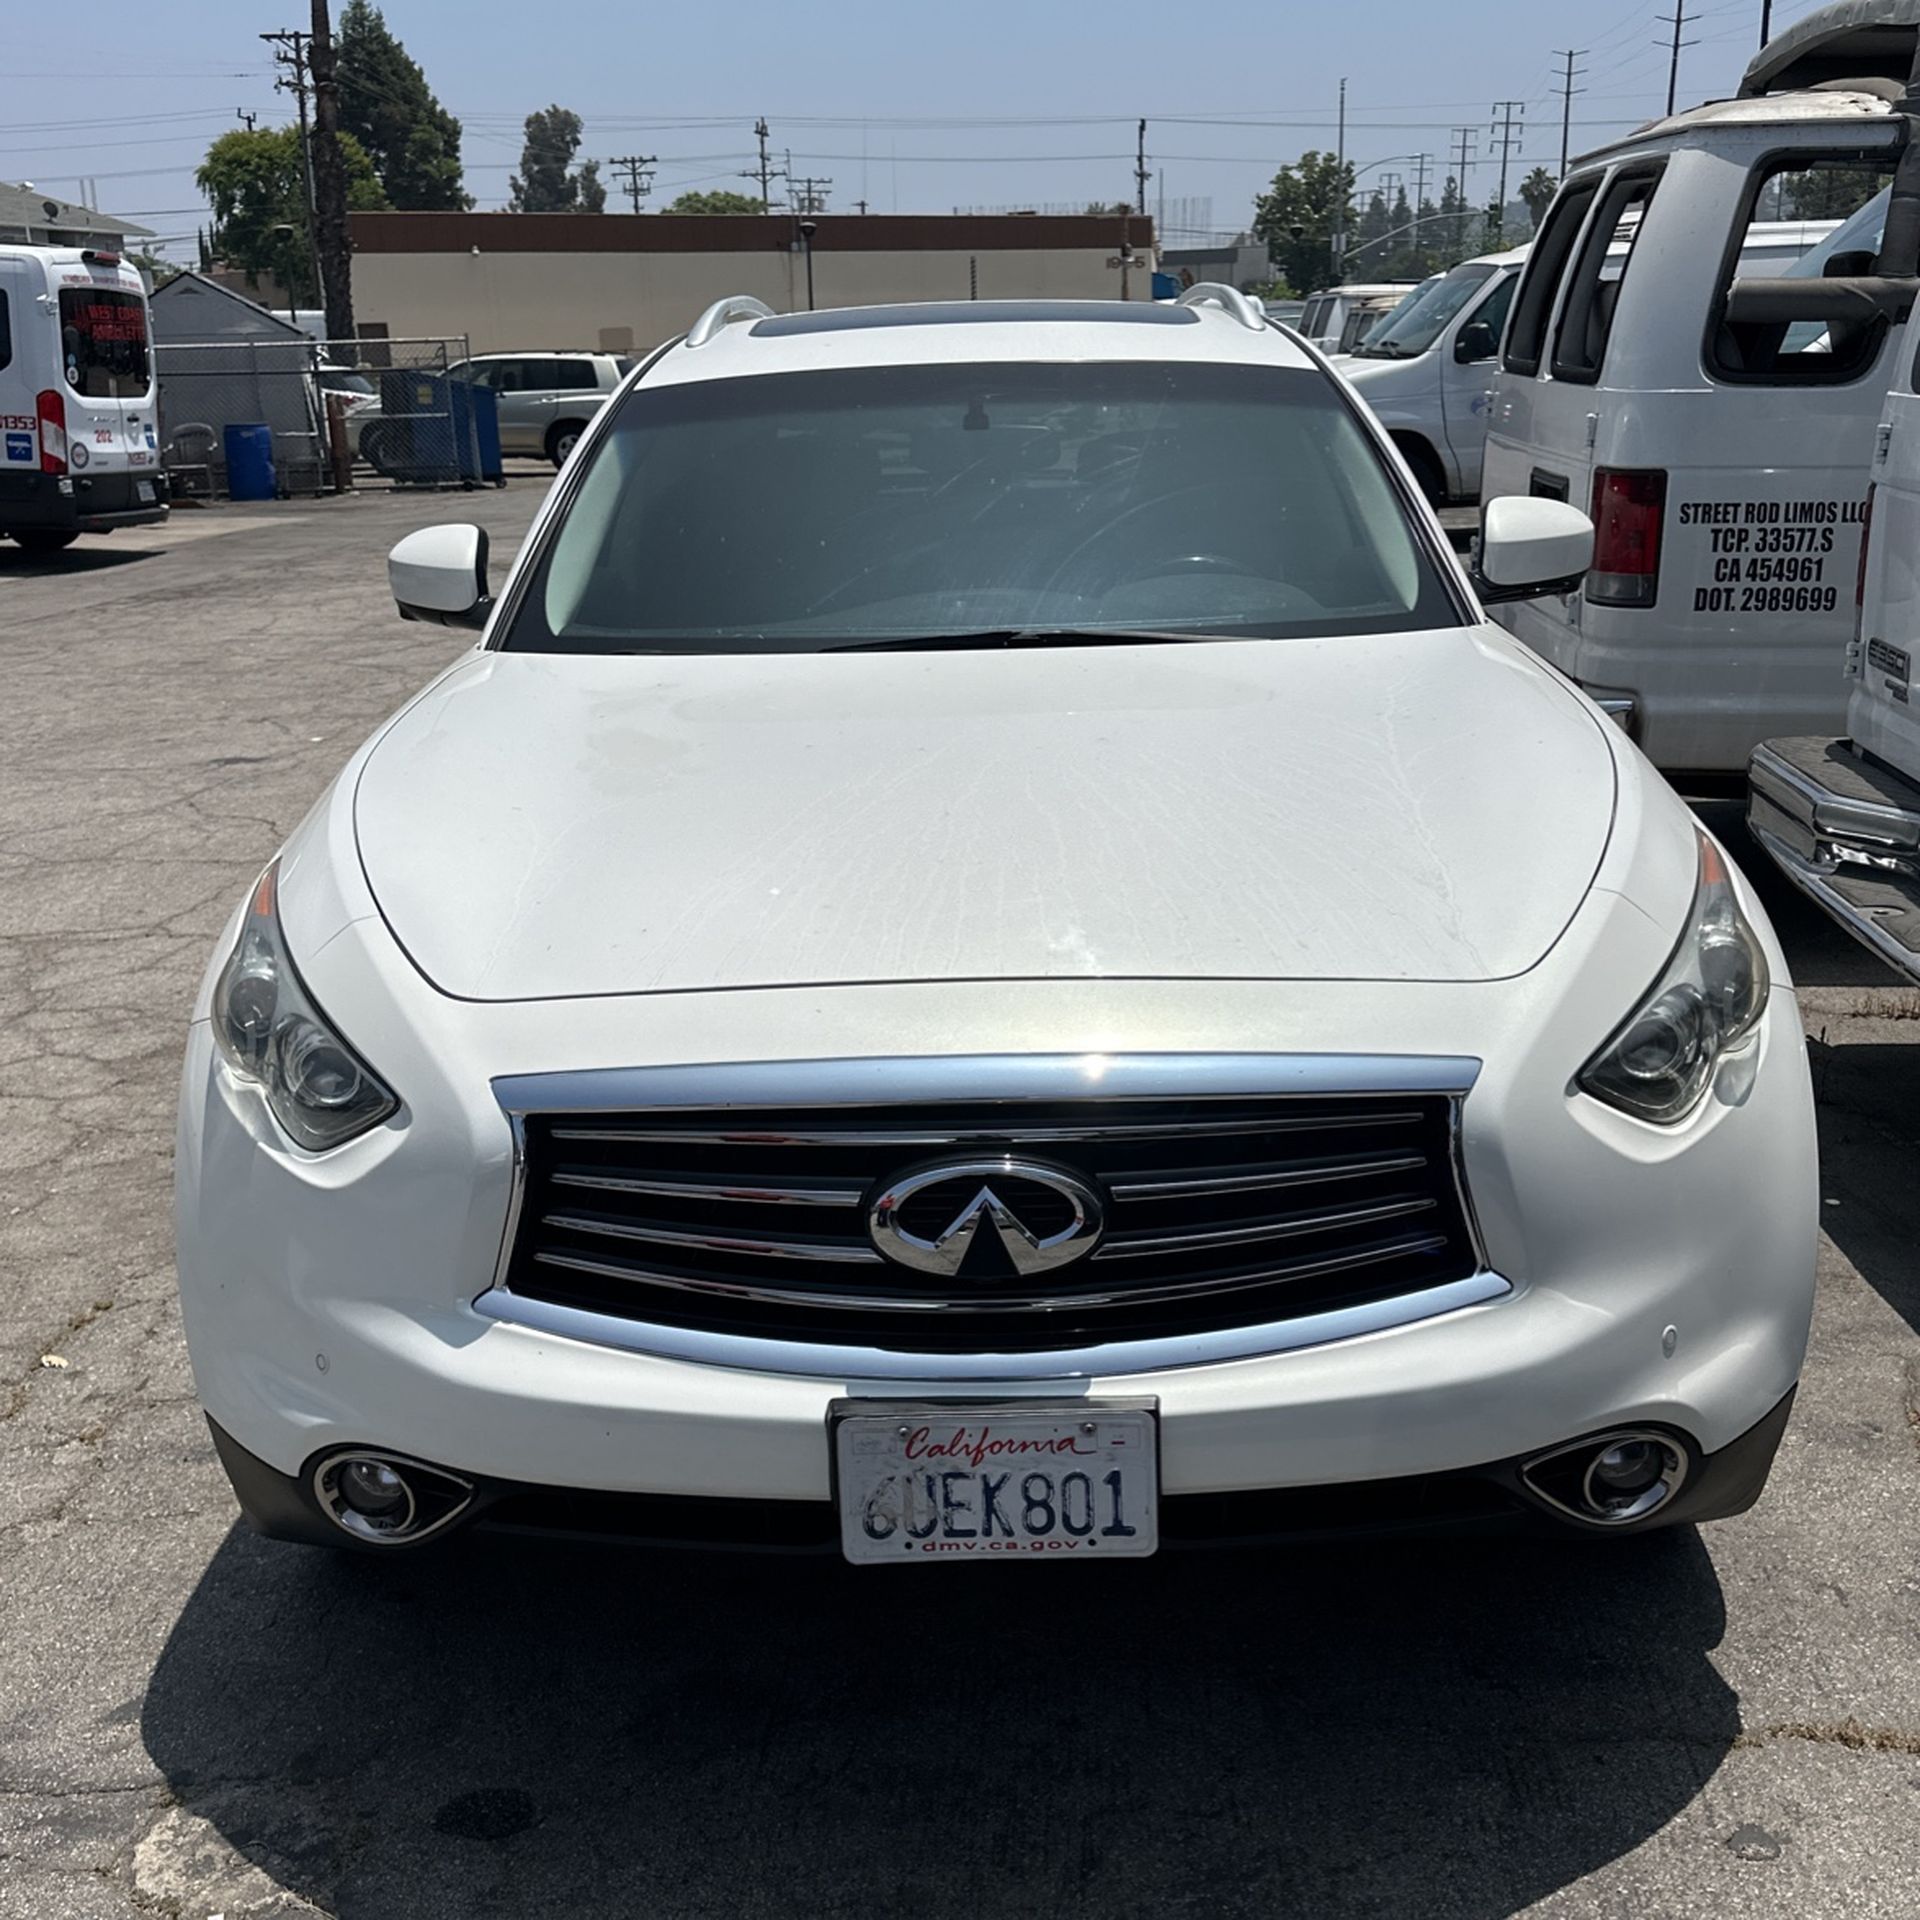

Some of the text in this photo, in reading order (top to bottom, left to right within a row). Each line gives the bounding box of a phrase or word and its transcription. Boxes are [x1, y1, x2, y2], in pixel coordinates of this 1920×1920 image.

[1106, 256, 1145, 269] 195
[0, 415, 37, 430] 1353
[1680, 501, 1867, 524] STREET ROD LIMOS LLC
[1711, 528, 1749, 553] TCP.
[1714, 557, 1824, 582] CA 454961
[1693, 587, 1837, 612] DOT. 2989699
[904, 1426, 1097, 1467] California
[862, 1469, 1137, 1540] 6UEK801
[922, 1539, 1079, 1552] dmv.ca.gov
